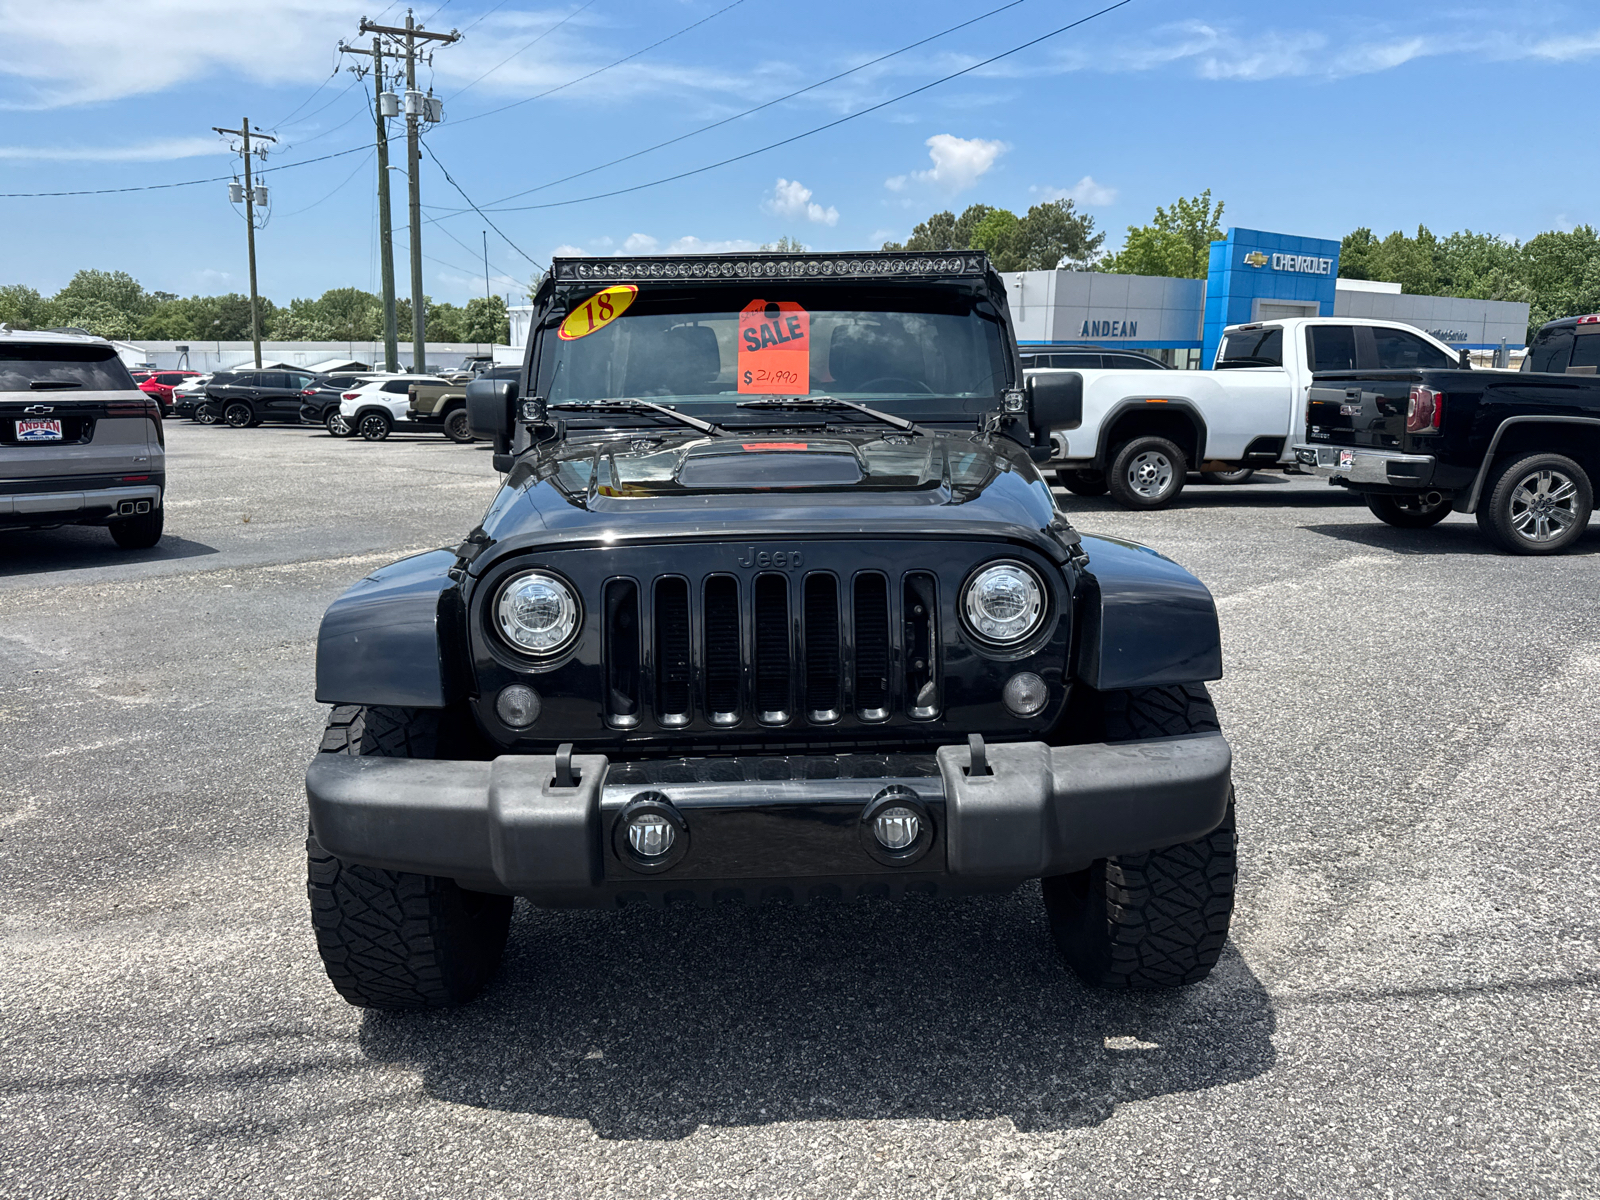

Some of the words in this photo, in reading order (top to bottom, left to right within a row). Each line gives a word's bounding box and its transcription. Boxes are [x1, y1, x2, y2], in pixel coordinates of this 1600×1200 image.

[1272, 253, 1333, 275] CHEVROLET
[583, 292, 614, 333] 18
[743, 315, 804, 352] SALE
[1079, 320, 1138, 337] ANDEAN
[18, 421, 60, 434] ANDEAN
[738, 546, 804, 572] Jeep
